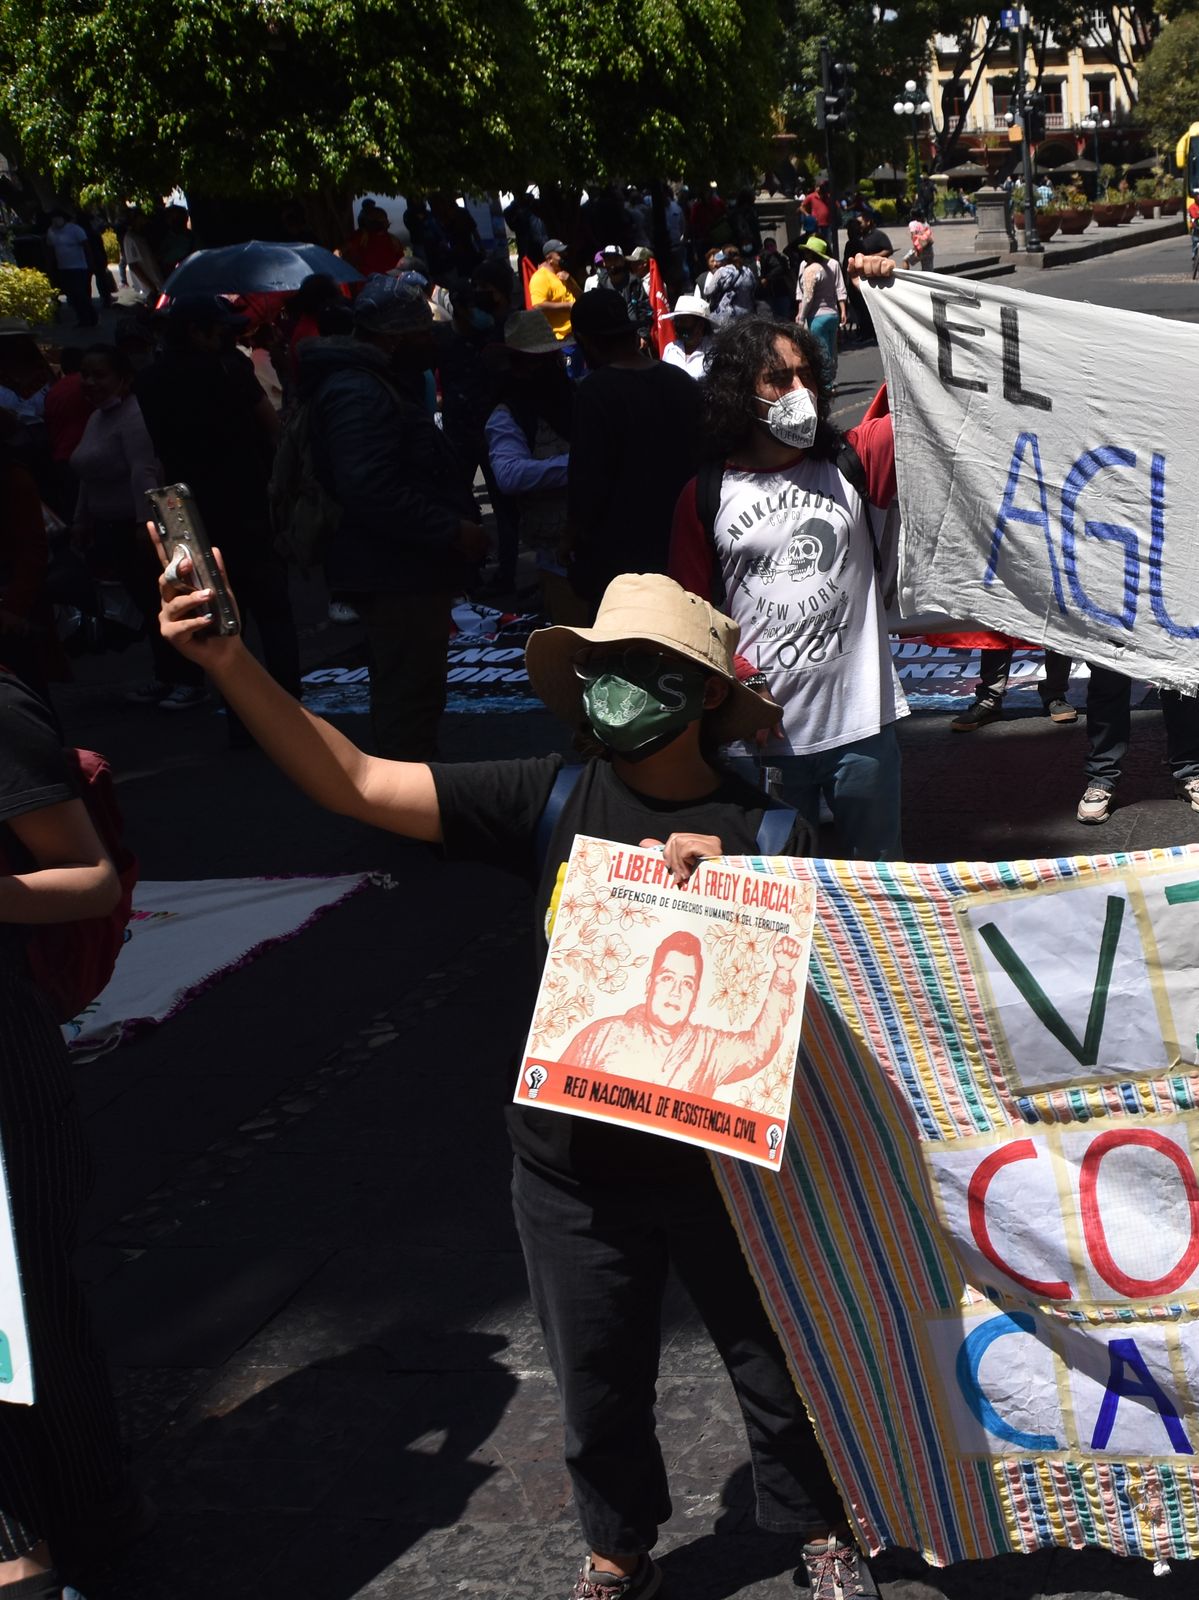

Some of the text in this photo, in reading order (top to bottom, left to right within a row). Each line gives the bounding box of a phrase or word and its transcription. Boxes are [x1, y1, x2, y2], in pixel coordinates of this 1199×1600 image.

[930, 291, 1052, 412] EL
[727, 489, 836, 541] NUKLHEADS
[756, 578, 839, 621] NEW YORK
[808, 605, 838, 626] POISON
[611, 887, 657, 905] DEFENSOR
[659, 897, 669, 907] DE
[672, 899, 703, 915] DERECHOS
[704, 907, 734, 922] HUMANOS
[741, 914, 752, 926] DEL
[755, 917, 790, 934] TERRITORIO
[692, 869, 700, 895] A
[705, 869, 741, 902] FREDY
[743, 877, 796, 914] GARCIA!
[563, 1076, 757, 1144] RED NACIONAL DE RESISTENCIA CIVIL
